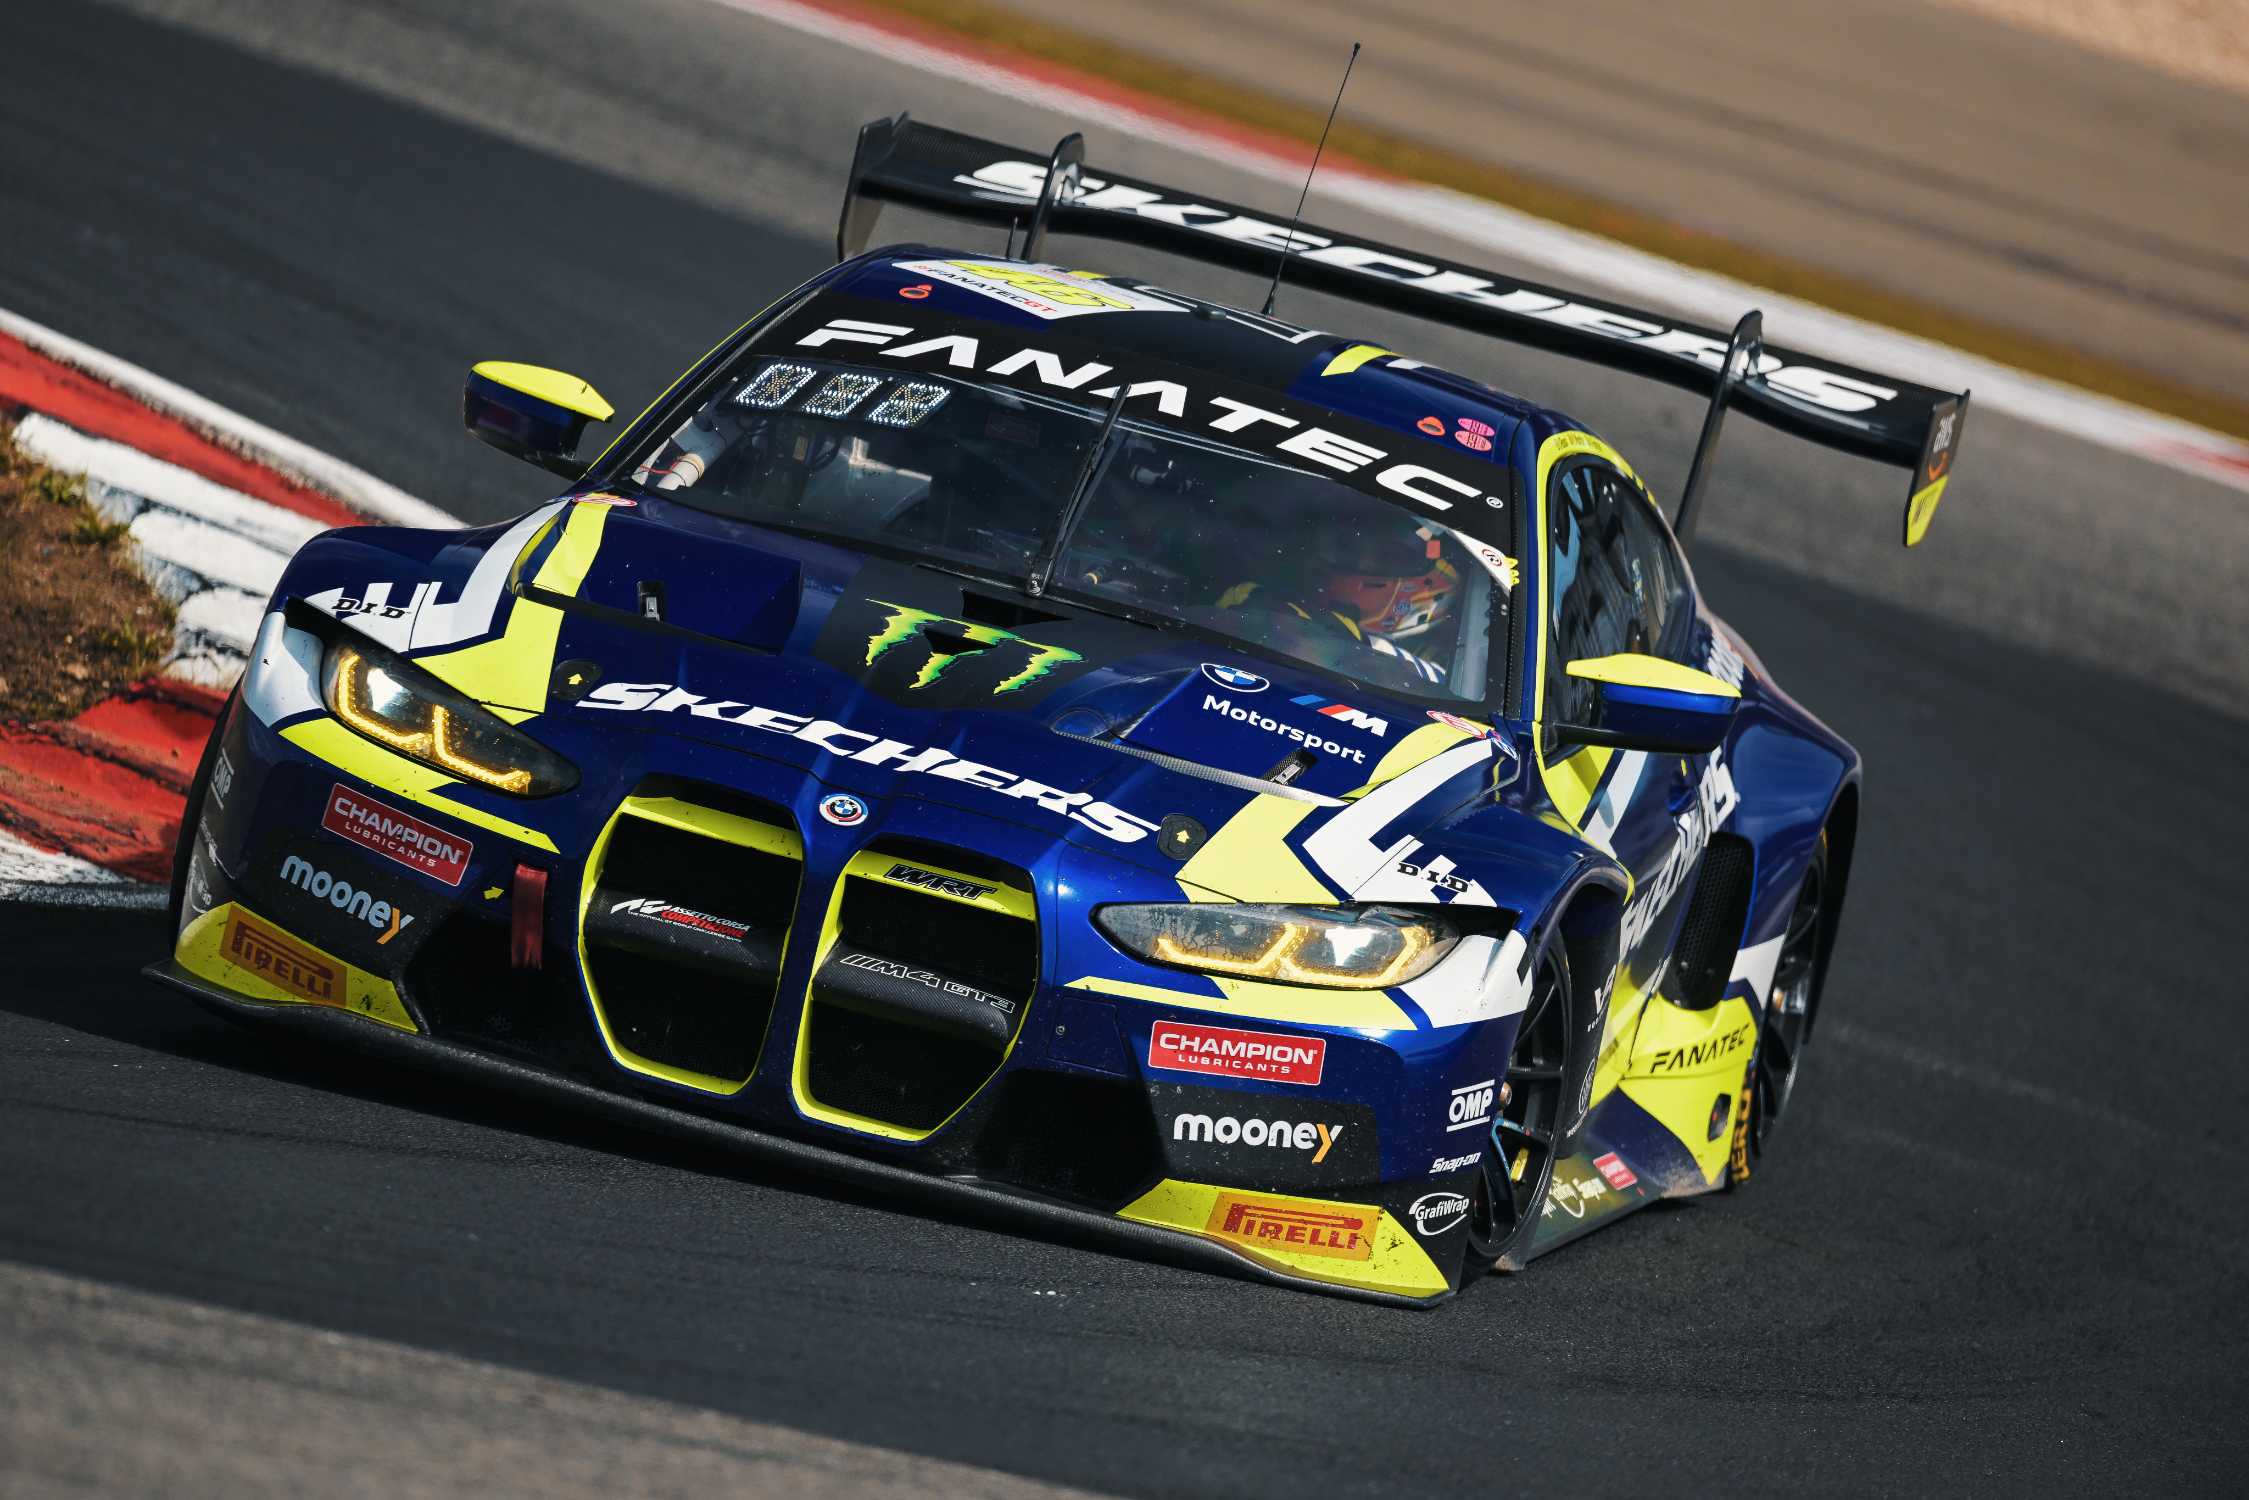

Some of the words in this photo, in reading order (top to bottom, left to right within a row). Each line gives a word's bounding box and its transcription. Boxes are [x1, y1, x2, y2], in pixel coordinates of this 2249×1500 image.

[953, 160, 1898, 412] SKECHERS
[797, 319, 1483, 511] FANATEC
[1202, 694, 1367, 765] Motorsport
[575, 682, 1162, 843] SKECHERS
[334, 797, 462, 865] CHAMPION
[344, 821, 439, 867] LUBRICANTS
[280, 855, 415, 945] mooney
[885, 863, 998, 900] WRT
[670, 906, 718, 924] ASSETTO
[717, 917, 751, 932] CORSA
[231, 920, 335, 1000] PIRELLI
[1159, 1032, 1314, 1065] CHAMPION
[1178, 1054, 1291, 1075] LUBRICANTS
[1649, 1023, 1750, 1074] FANATEC
[1448, 1087, 1494, 1123] OMP
[1173, 1113, 1344, 1165] mooney
[1429, 1151, 1482, 1174] Snap-on
[1222, 1202, 1364, 1250] PIRELLI
[1415, 1197, 1470, 1222] GrafiWrap
